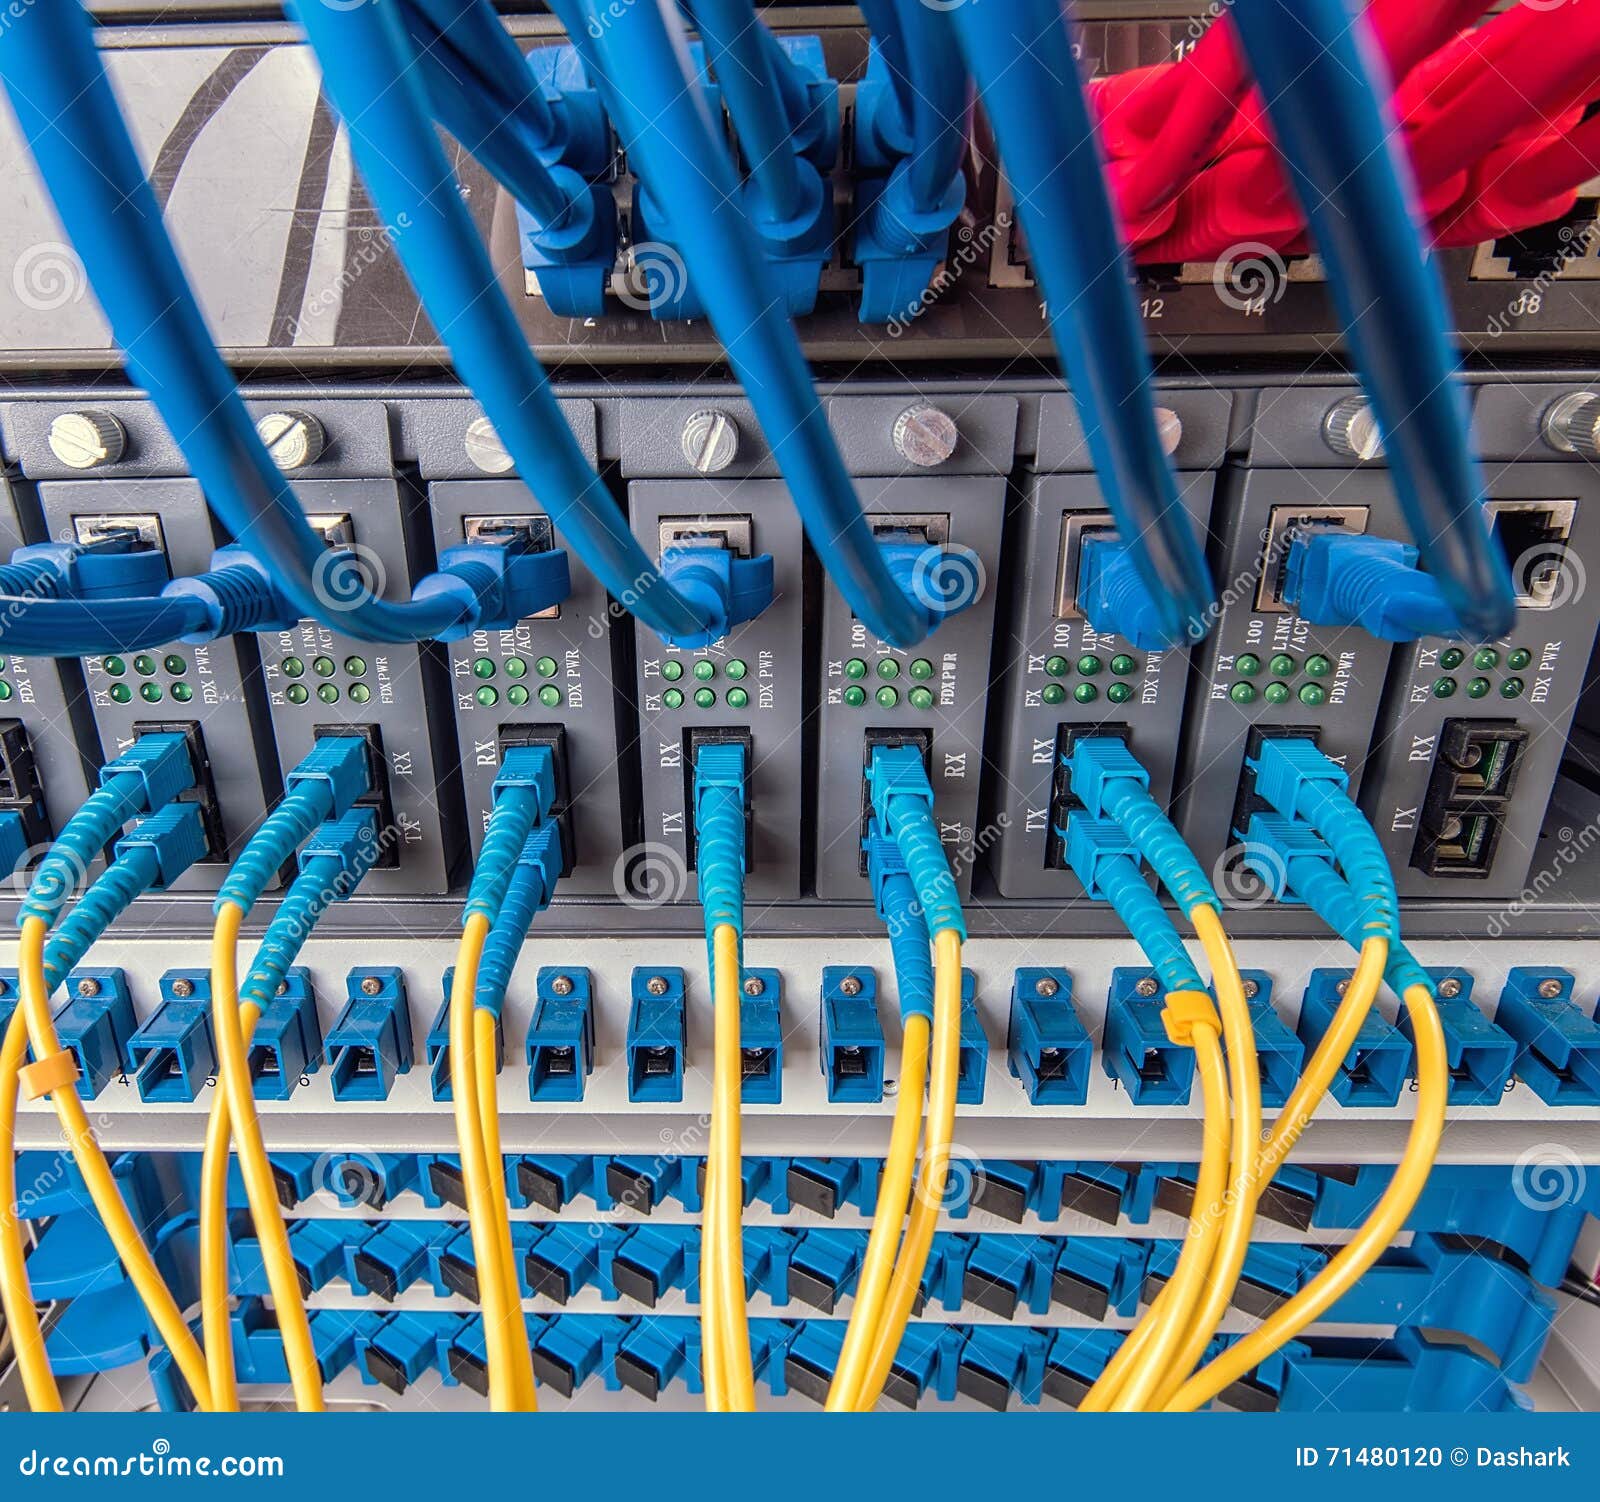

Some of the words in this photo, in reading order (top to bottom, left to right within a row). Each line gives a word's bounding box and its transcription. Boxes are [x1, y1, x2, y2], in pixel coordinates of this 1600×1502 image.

[1140, 299, 1164, 319] 12
[1243, 298, 1266, 317] 14
[1518, 295, 1541, 314] 18
[279, 631, 294, 653] 100
[301, 627, 318, 657] LINK
[473, 630, 489, 653] 100
[500, 629, 515, 656] LIN
[851, 624, 866, 649] 100
[1053, 624, 1071, 649] 100
[1246, 620, 1264, 645] 100
[1272, 616, 1293, 651] LINK
[1289, 618, 1310, 652] /ACT
[10, 656, 28, 674] PW
[85, 656, 103, 674] TX
[194, 646, 212, 675] PWR
[375, 656, 391, 681] PWR
[454, 658, 470, 678] TX
[566, 648, 581, 678] PWR
[644, 658, 660, 678] TX
[759, 649, 774, 678] PWR
[828, 660, 842, 677] TX
[943, 652, 957, 680] PWR
[1028, 654, 1046, 674] TX
[1146, 650, 1163, 673] PW
[1217, 655, 1234, 672] TX
[1335, 651, 1356, 679] PWR
[1418, 648, 1438, 668] TX
[1540, 640, 1562, 672] PWR
[267, 663, 280, 679] TX
[17, 679, 35, 704] FDX
[94, 690, 111, 706] FX
[202, 679, 219, 705] FDX
[272, 687, 285, 706] FX
[378, 682, 394, 704] FDX
[459, 692, 474, 711] FX
[568, 683, 583, 708] FDX
[646, 693, 661, 711] FX
[759, 682, 774, 709] FDX
[940, 681, 955, 705] FDX
[1025, 689, 1042, 708] FX
[1142, 679, 1159, 705] FDX
[1211, 683, 1228, 700] FX
[1329, 680, 1348, 704] FDX
[1410, 683, 1430, 703] FX
[1530, 677, 1552, 704] FDX
[476, 740, 498, 767] RX
[660, 741, 681, 768] RX
[1032, 737, 1056, 764] RX
[1408, 734, 1436, 762] RX
[392, 751, 413, 776] RX
[944, 752, 967, 778] RX
[403, 819, 422, 844] TX
[662, 811, 683, 836] TX
[1025, 807, 1048, 833] TX
[1391, 807, 1417, 832] TX
[940, 821, 963, 846] TX
[118, 1074, 131, 1088] 4
